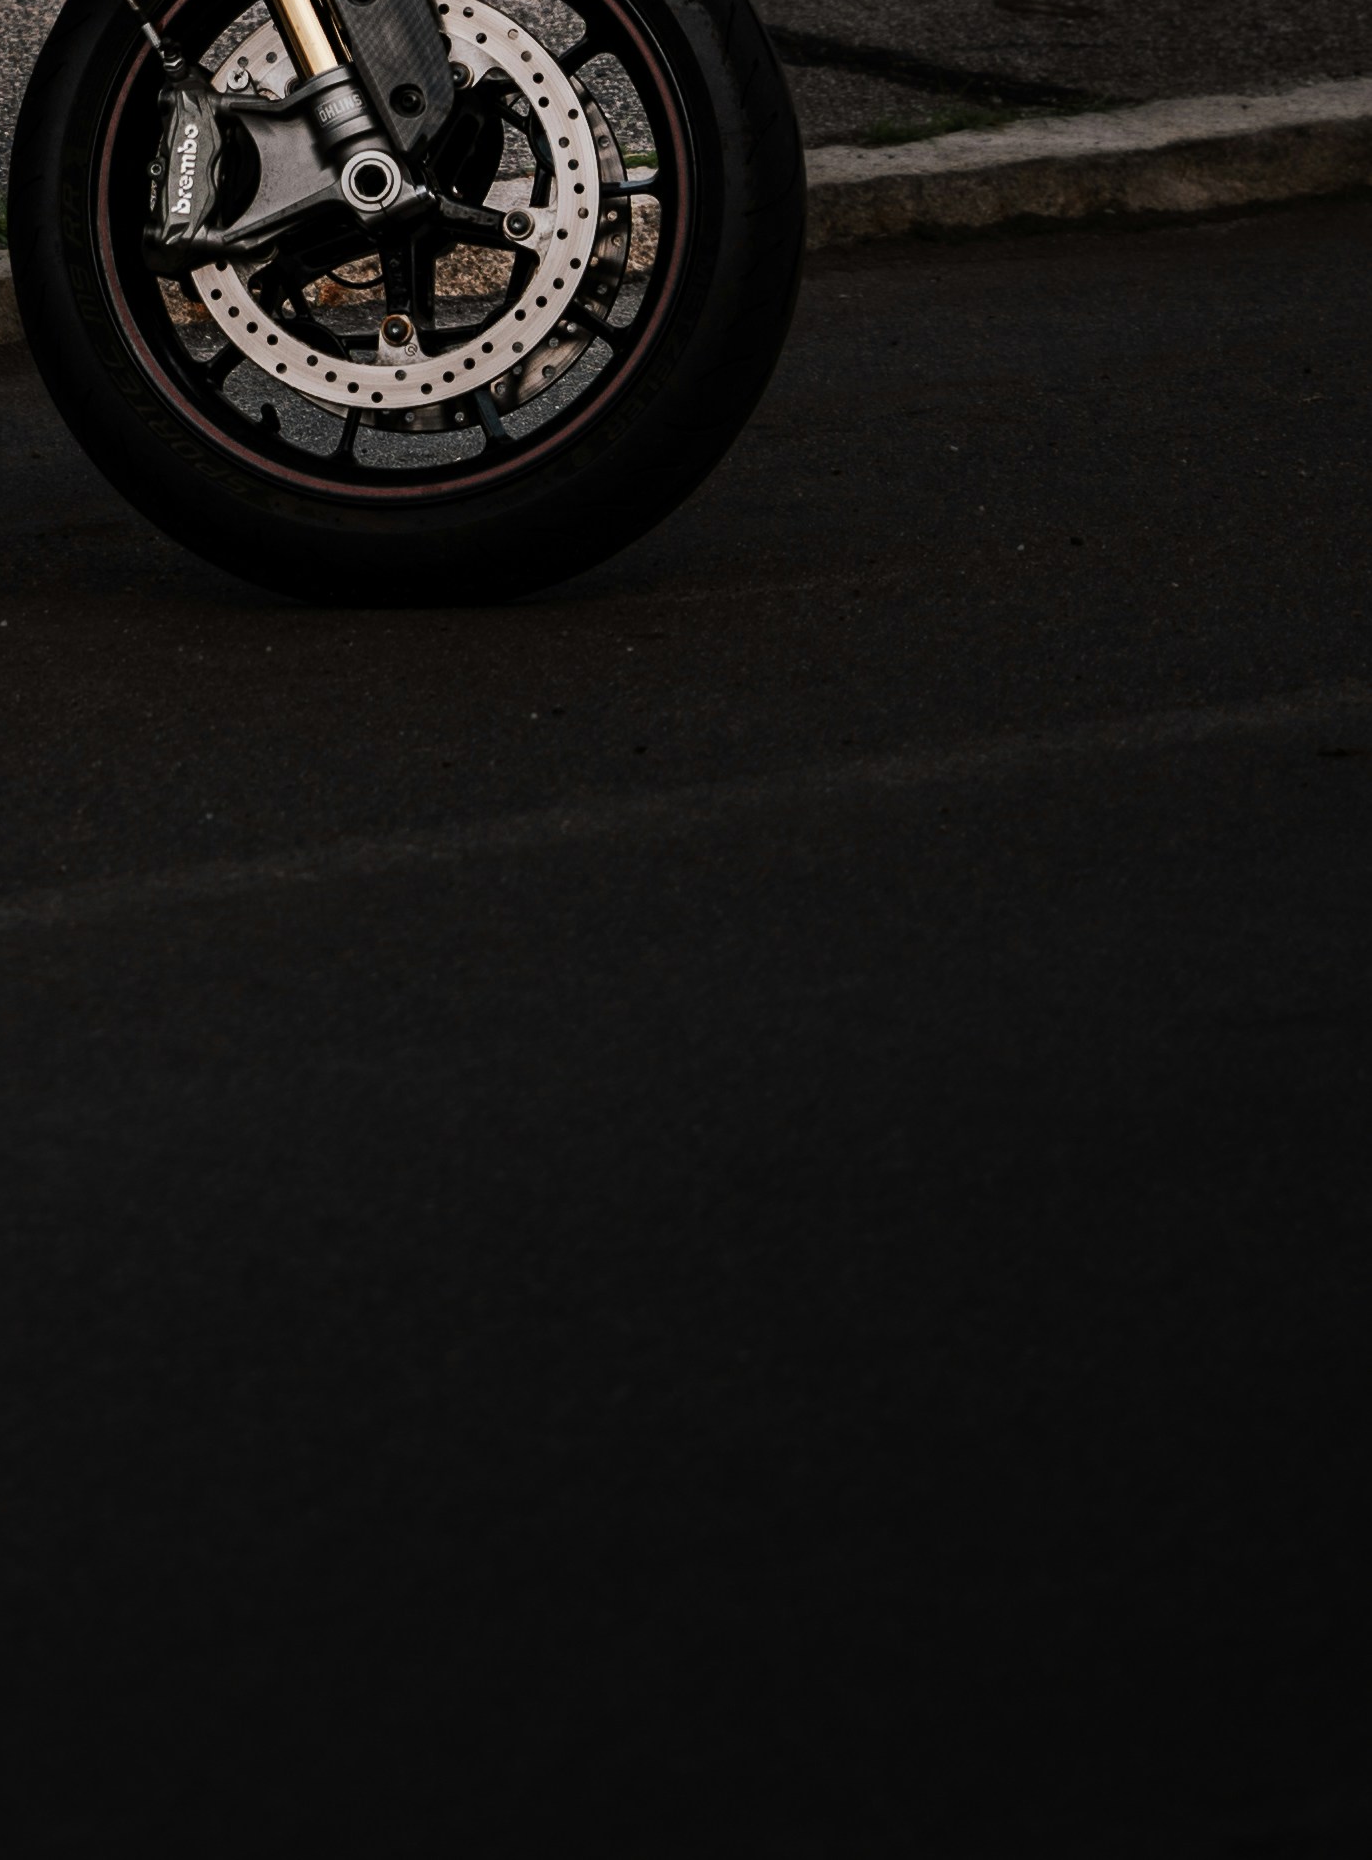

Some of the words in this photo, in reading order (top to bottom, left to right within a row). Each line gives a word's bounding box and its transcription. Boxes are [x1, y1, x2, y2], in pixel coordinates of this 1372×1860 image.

[170, 123, 199, 215] brembo
[61, 181, 82, 250] RR
[94, 336, 252, 498] SPORTEC
